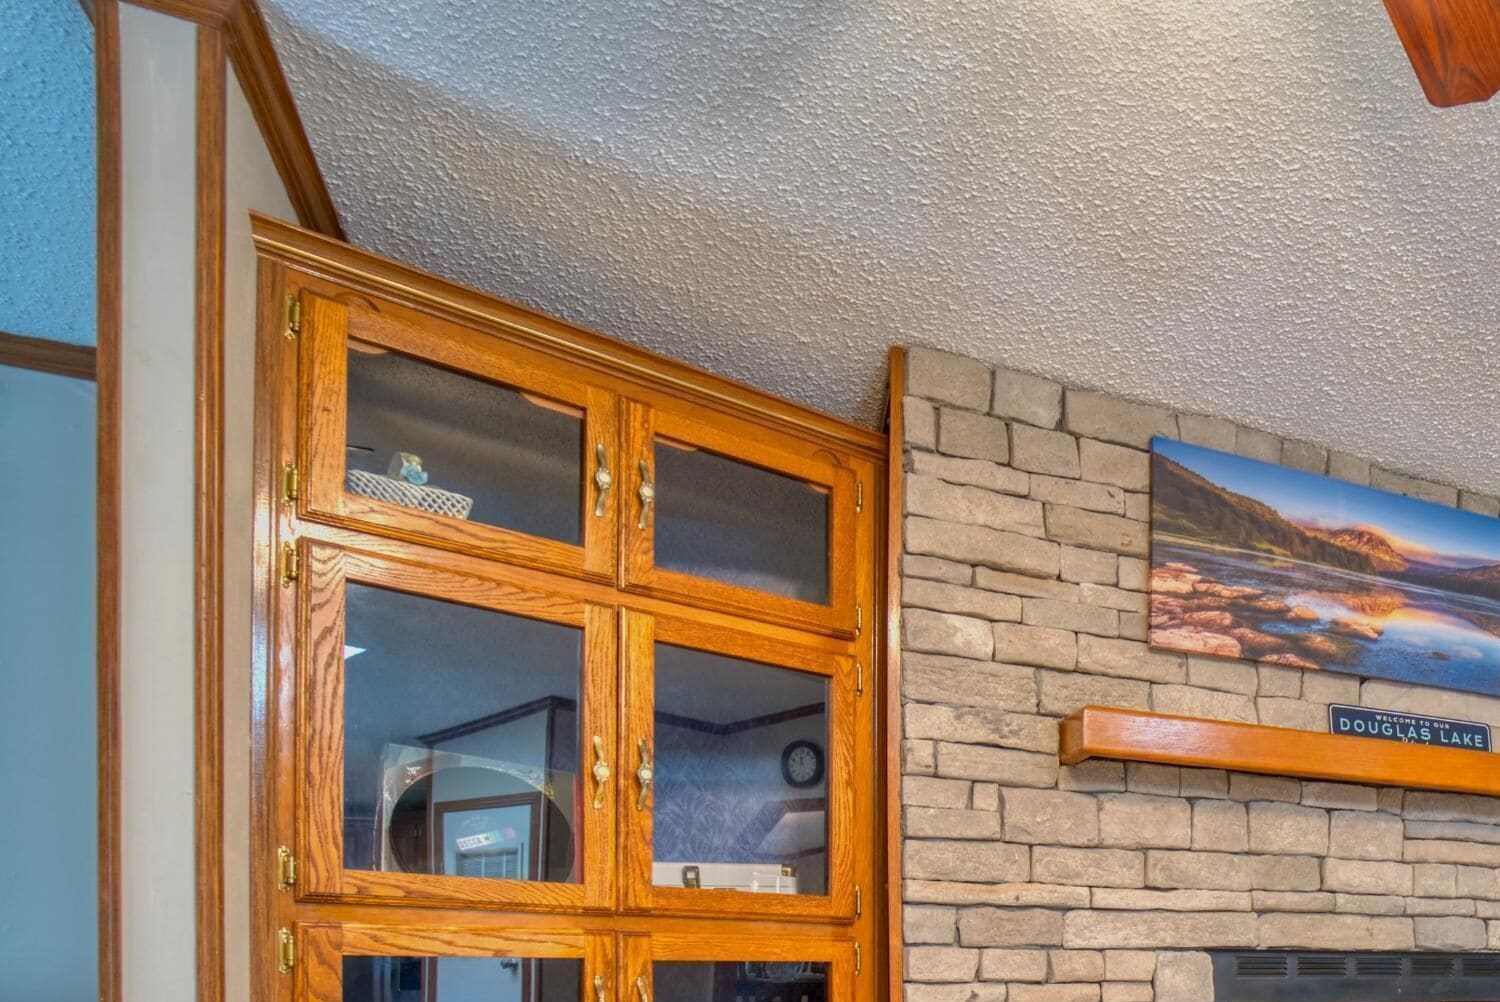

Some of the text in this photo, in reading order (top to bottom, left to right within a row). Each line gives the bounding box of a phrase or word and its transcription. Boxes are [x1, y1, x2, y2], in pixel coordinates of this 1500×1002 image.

[1375, 714, 1416, 725] WELCOME
[1339, 717, 1432, 740] DOUGLAS
[1440, 730, 1483, 747] LAKE
